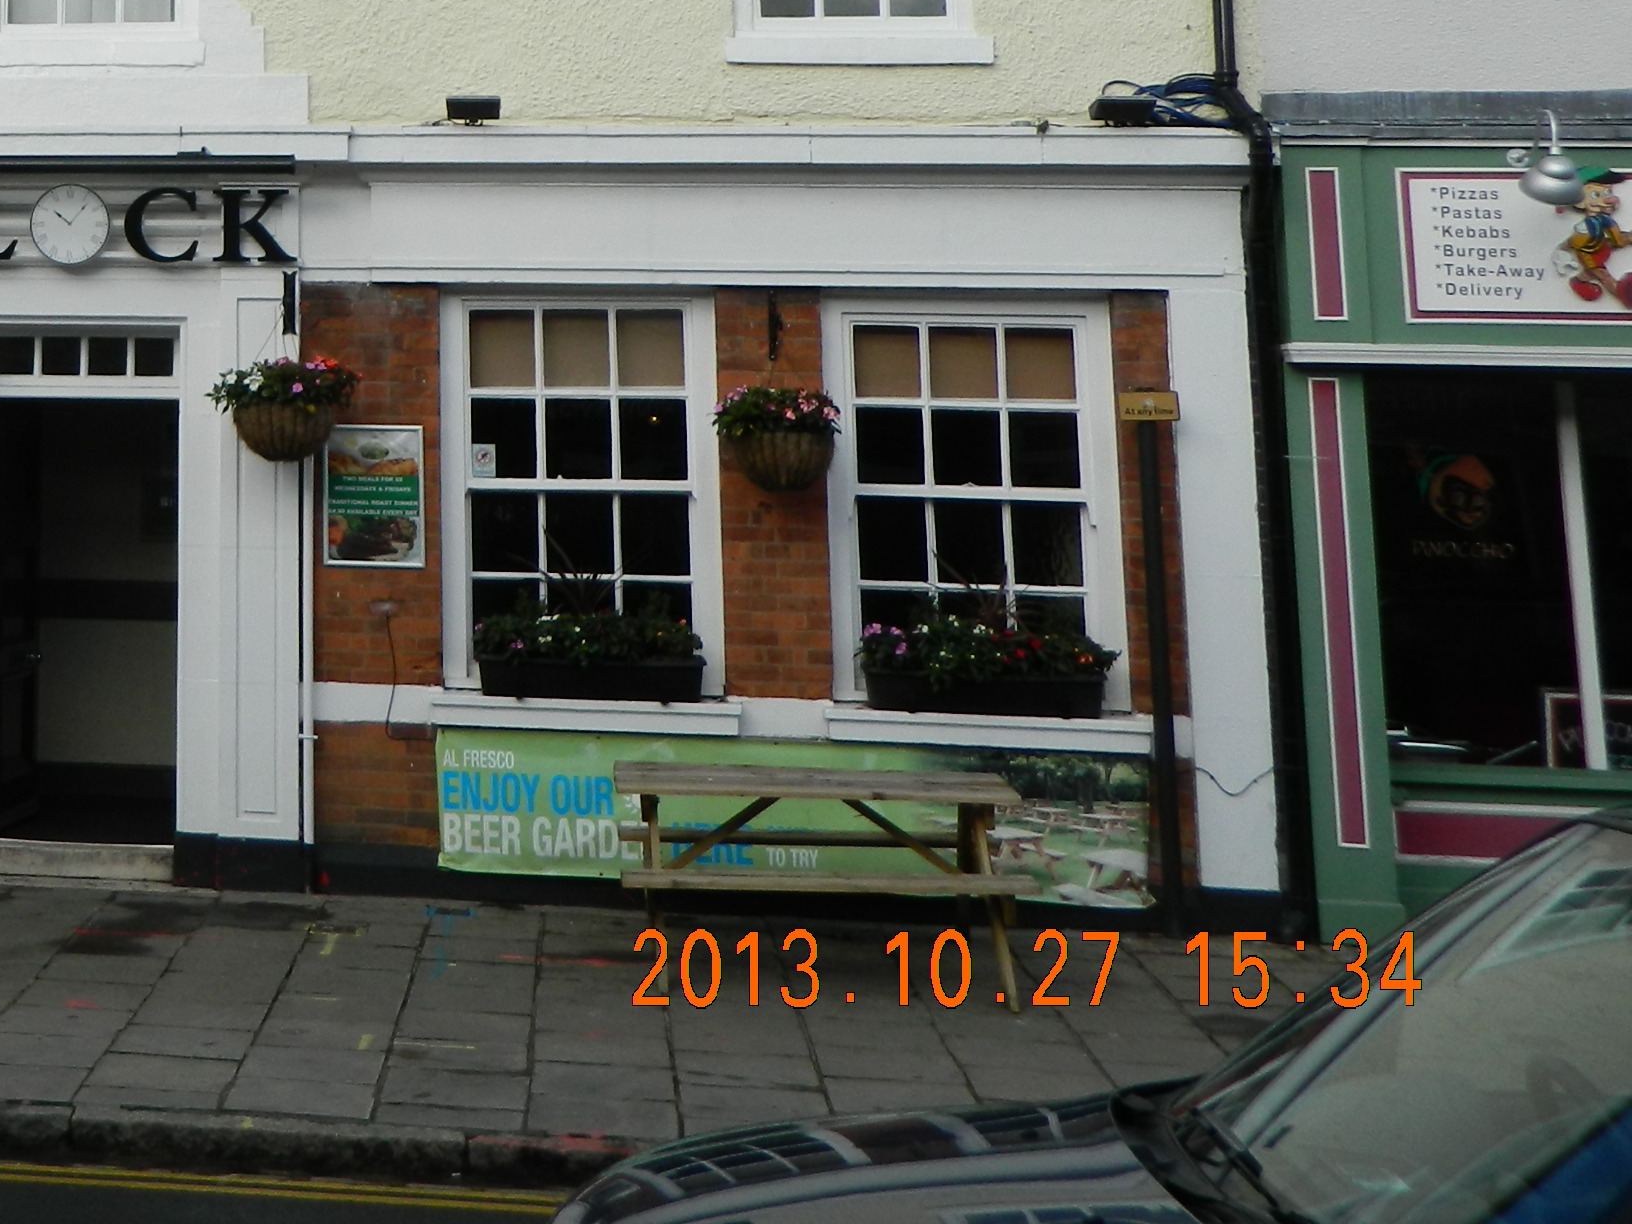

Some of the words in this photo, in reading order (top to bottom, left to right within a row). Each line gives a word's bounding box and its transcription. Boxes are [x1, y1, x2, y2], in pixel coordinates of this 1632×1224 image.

[443, 749, 459, 767] AL
[463, 750, 515, 769] FRESCO
[441, 771, 541, 813] ENJOY
[550, 774, 615, 816] OUR
[443, 813, 521, 856] BEER
[533, 816, 644, 860] GARDE
[766, 847, 786, 867] TO
[790, 848, 818, 869] TRY
